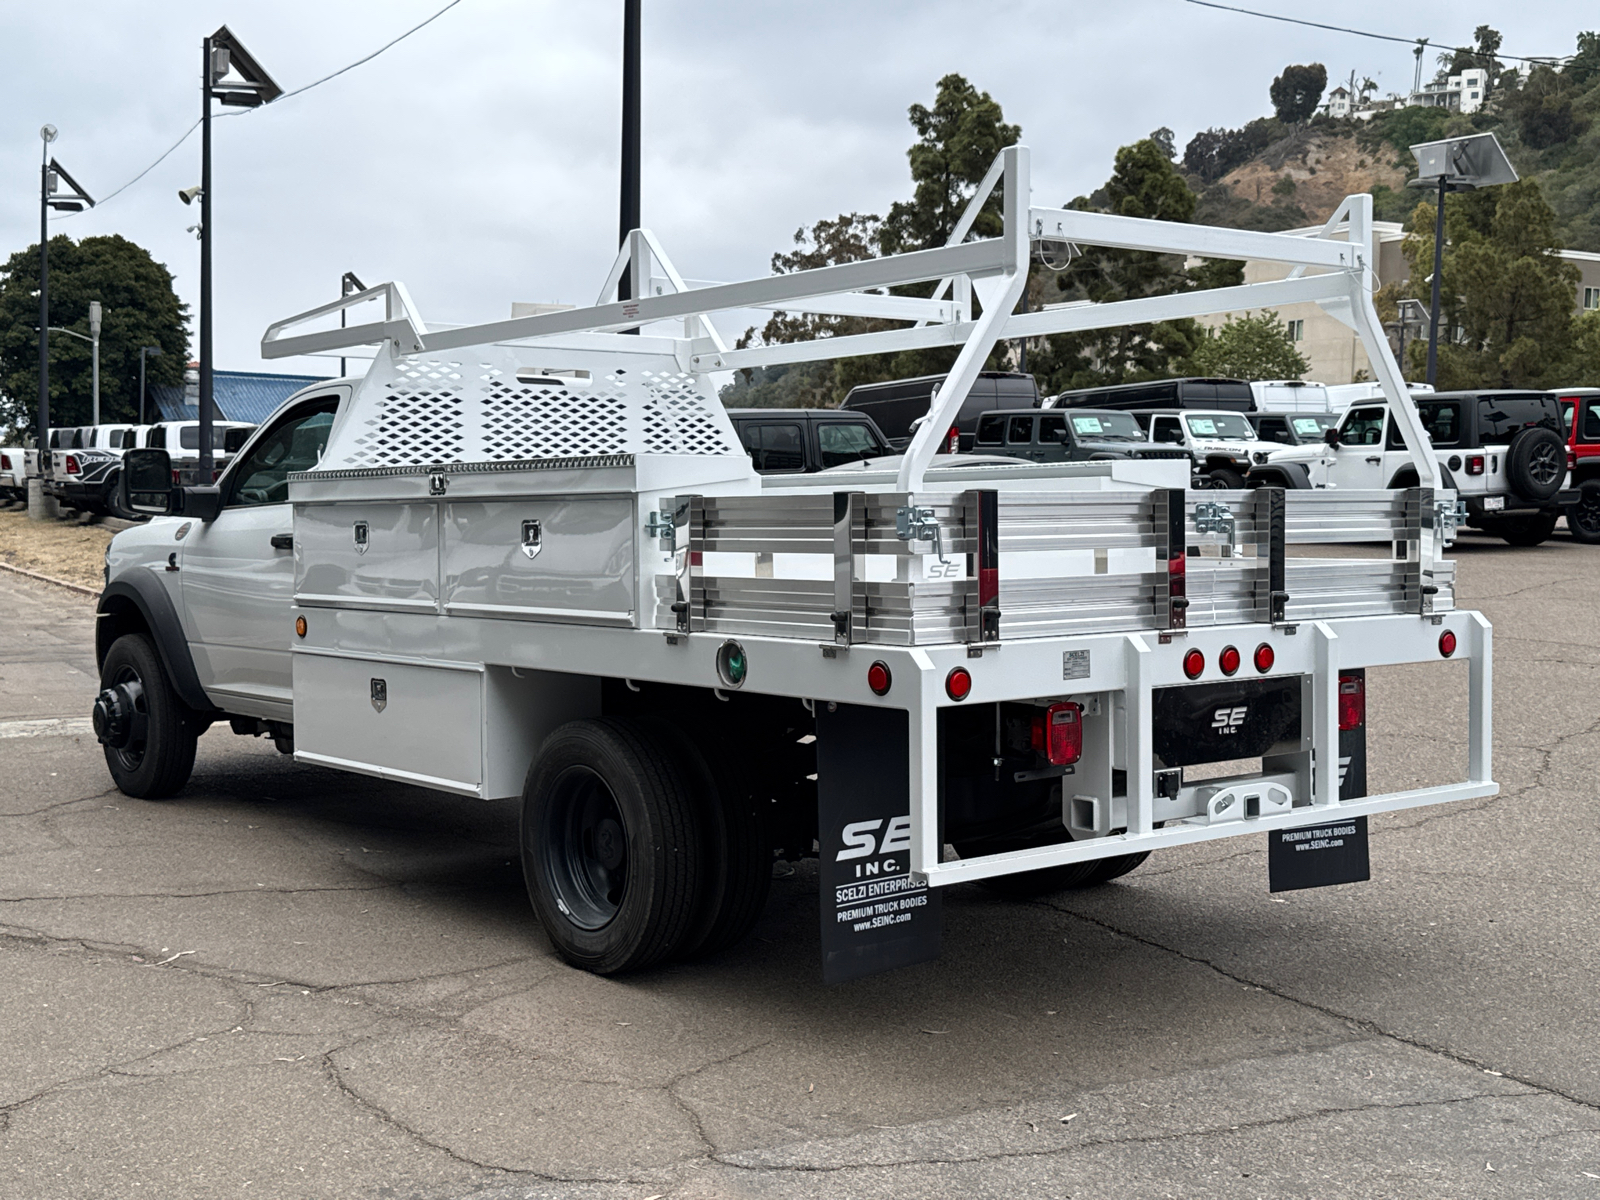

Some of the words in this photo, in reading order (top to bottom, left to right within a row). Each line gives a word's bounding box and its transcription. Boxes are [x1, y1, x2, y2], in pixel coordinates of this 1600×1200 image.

[927, 564, 961, 579] SE
[1211, 706, 1248, 728] SE
[835, 815, 911, 862] SE
[1282, 831, 1312, 842] PREMIUM
[1312, 828, 1333, 838] TRUCK
[1333, 825, 1356, 836] BODIES
[1295, 839, 1344, 852] www.SEINC.com
[855, 858, 900, 878] INC.
[836, 885, 867, 903] SCELZI
[837, 906, 874, 923] PREMIUM
[874, 901, 899, 915] TRUCK
[899, 895, 928, 910] BODIES
[853, 912, 912, 933] www.SEINC.com
